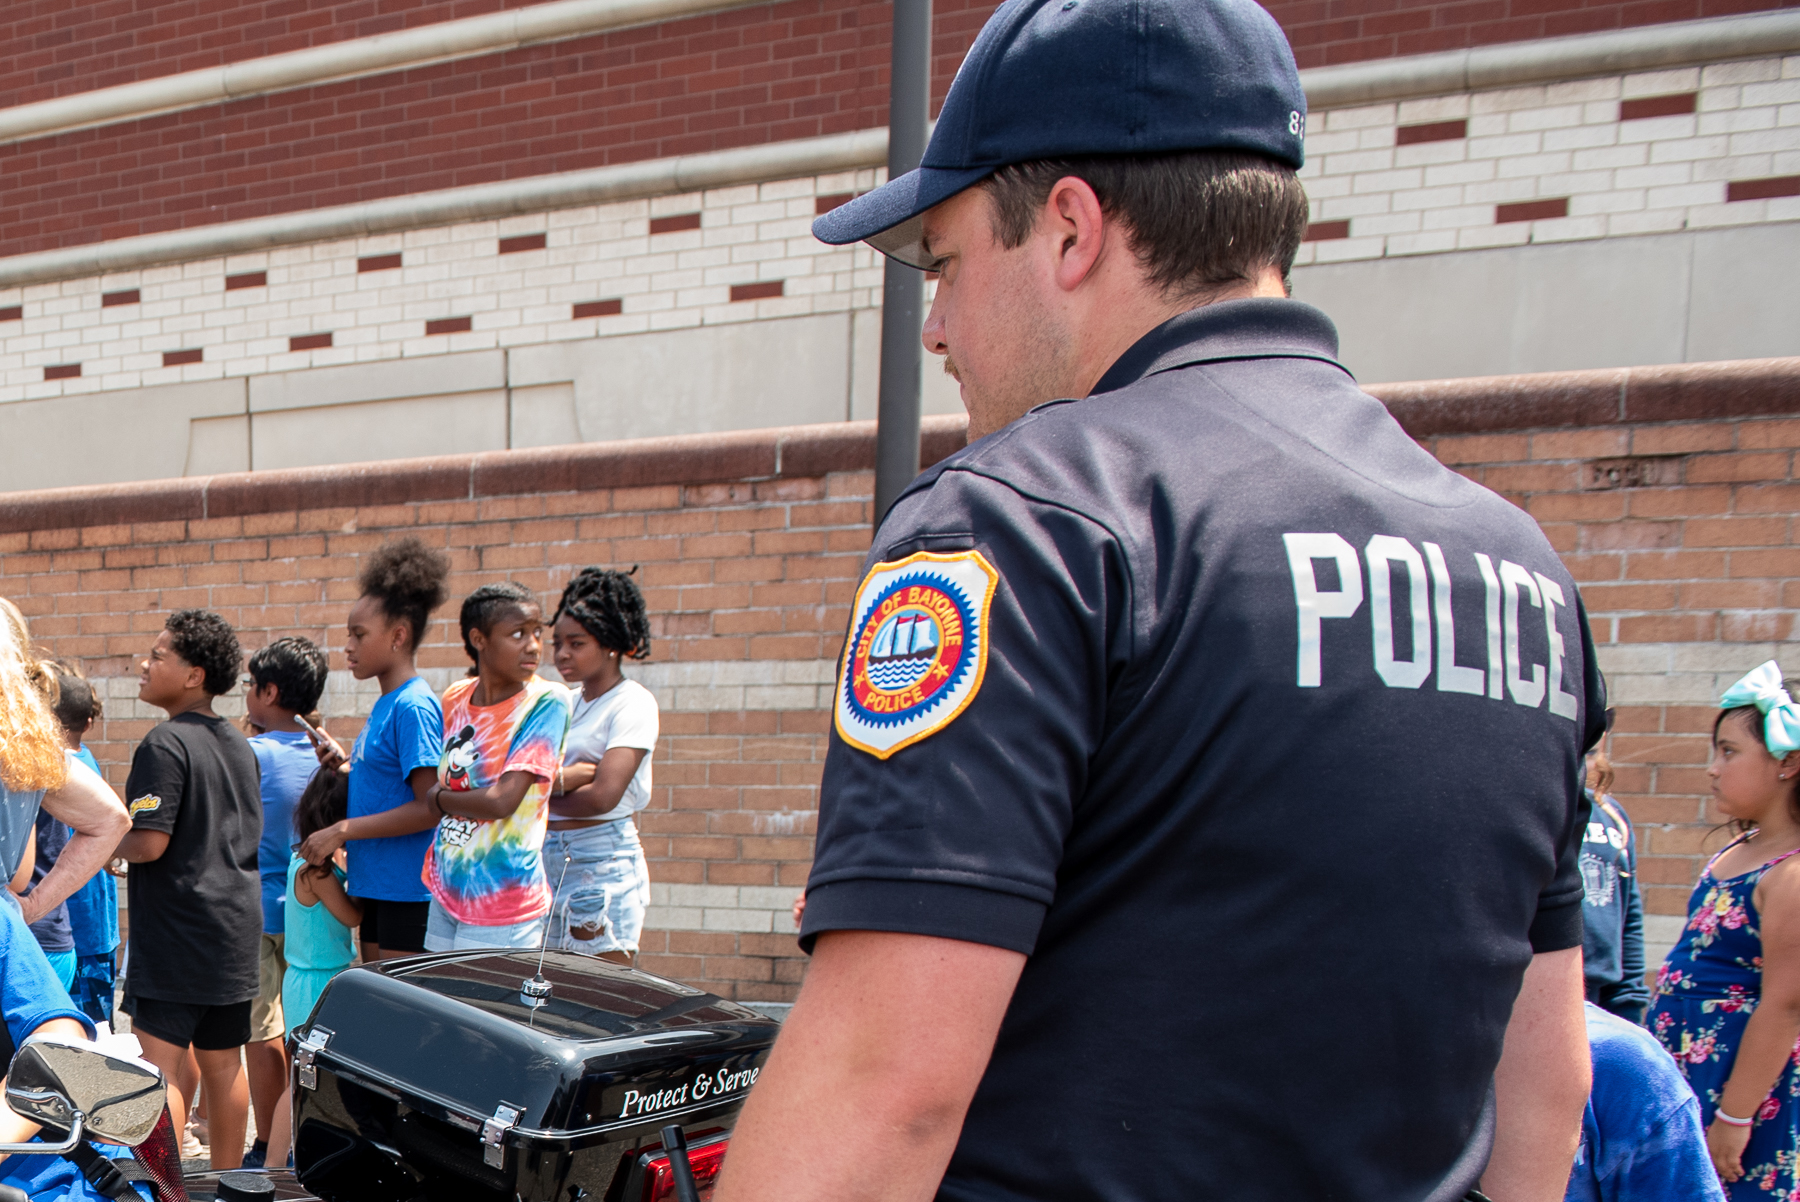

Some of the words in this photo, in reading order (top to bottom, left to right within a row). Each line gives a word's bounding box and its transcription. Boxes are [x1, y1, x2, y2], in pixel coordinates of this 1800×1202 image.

[856, 615, 878, 658] CITY
[882, 591, 902, 615] OF
[908, 586, 962, 647] BAYONNE
[1282, 532, 1578, 721] POLICE
[863, 686, 925, 712] POLICE
[619, 1082, 689, 1118] Protect
[691, 1073, 713, 1100] &
[712, 1067, 760, 1095] Serve
